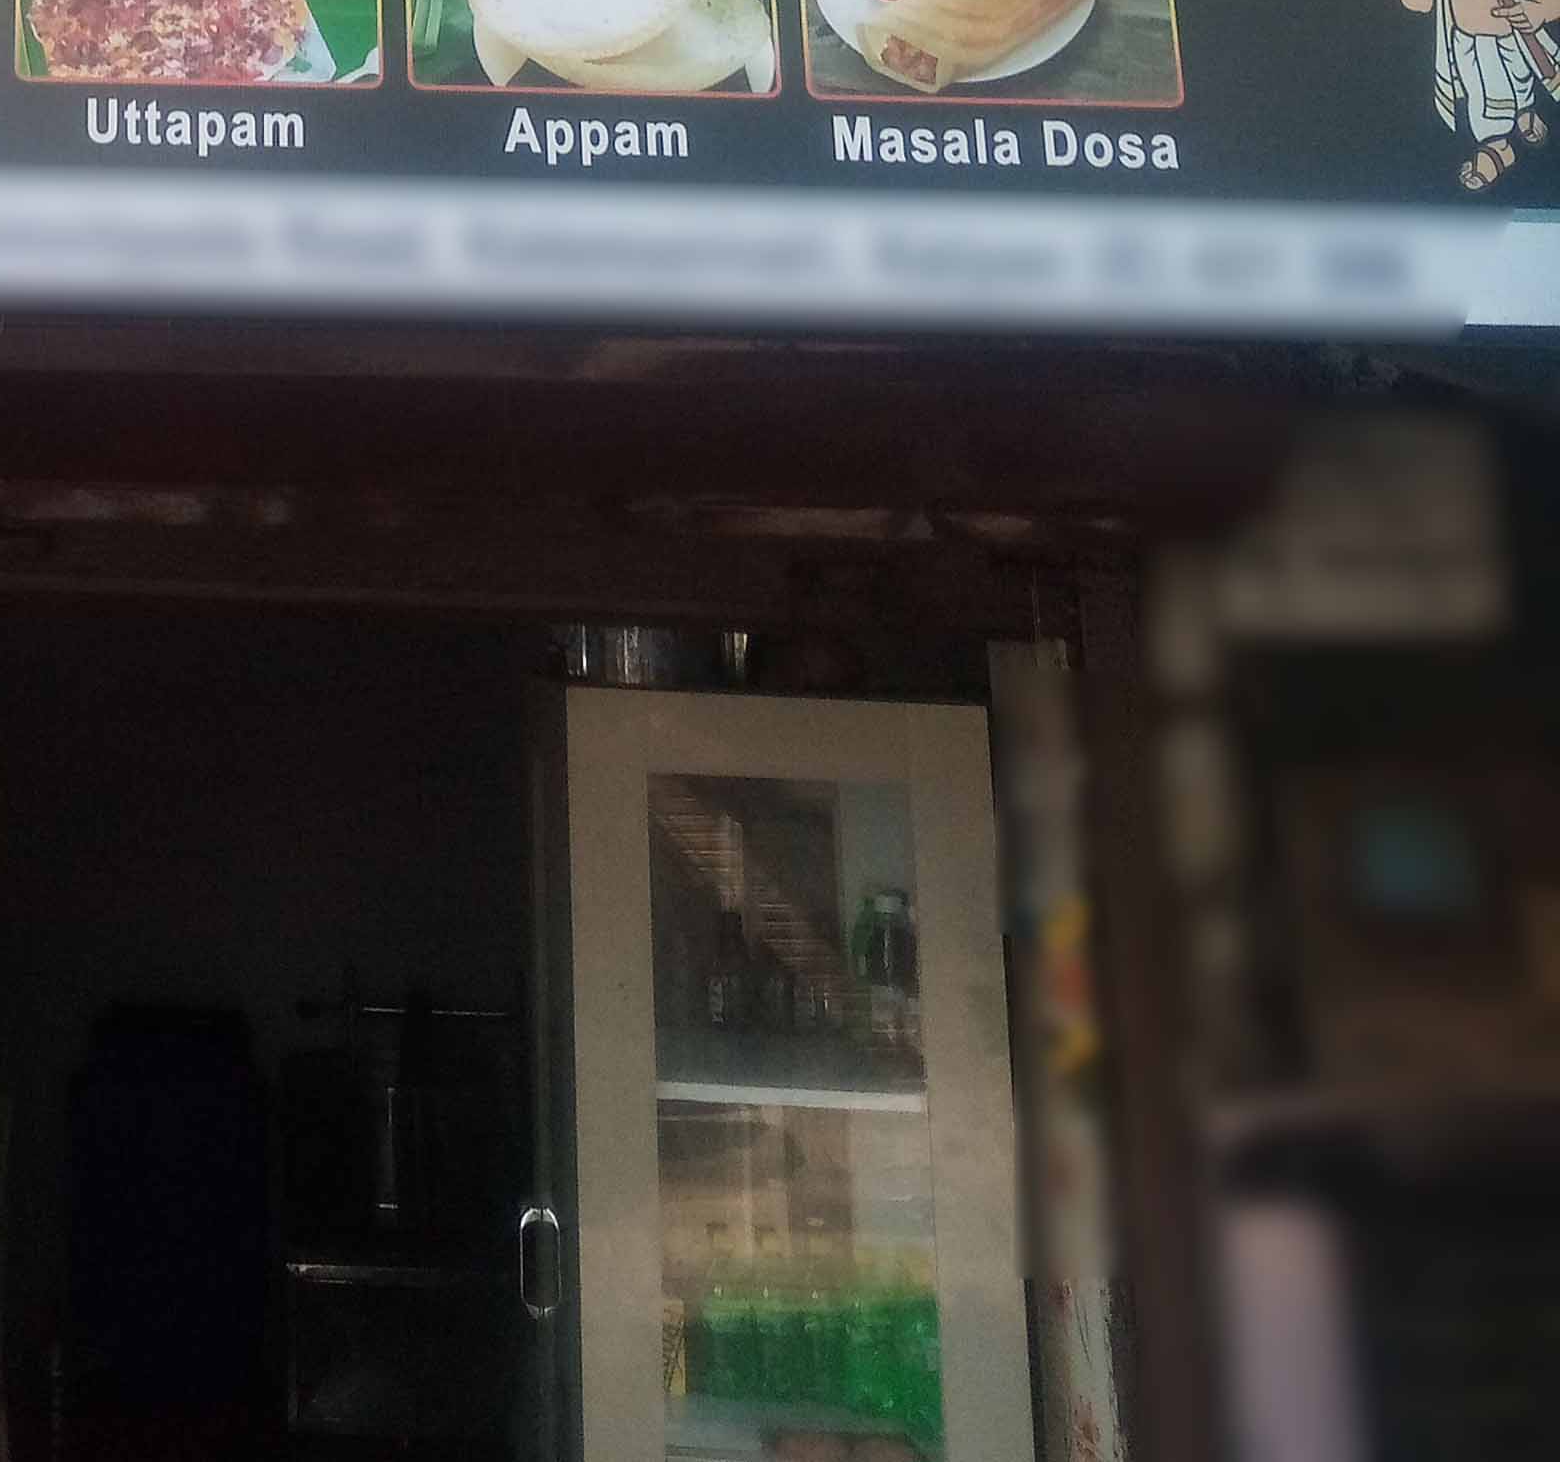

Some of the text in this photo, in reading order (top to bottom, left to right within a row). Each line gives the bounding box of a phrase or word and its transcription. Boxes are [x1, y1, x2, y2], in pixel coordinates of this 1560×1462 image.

[87, 97, 304, 155] Uttapam
[504, 107, 689, 166] Appam
[832, 115, 1179, 169] Masala Dosa
